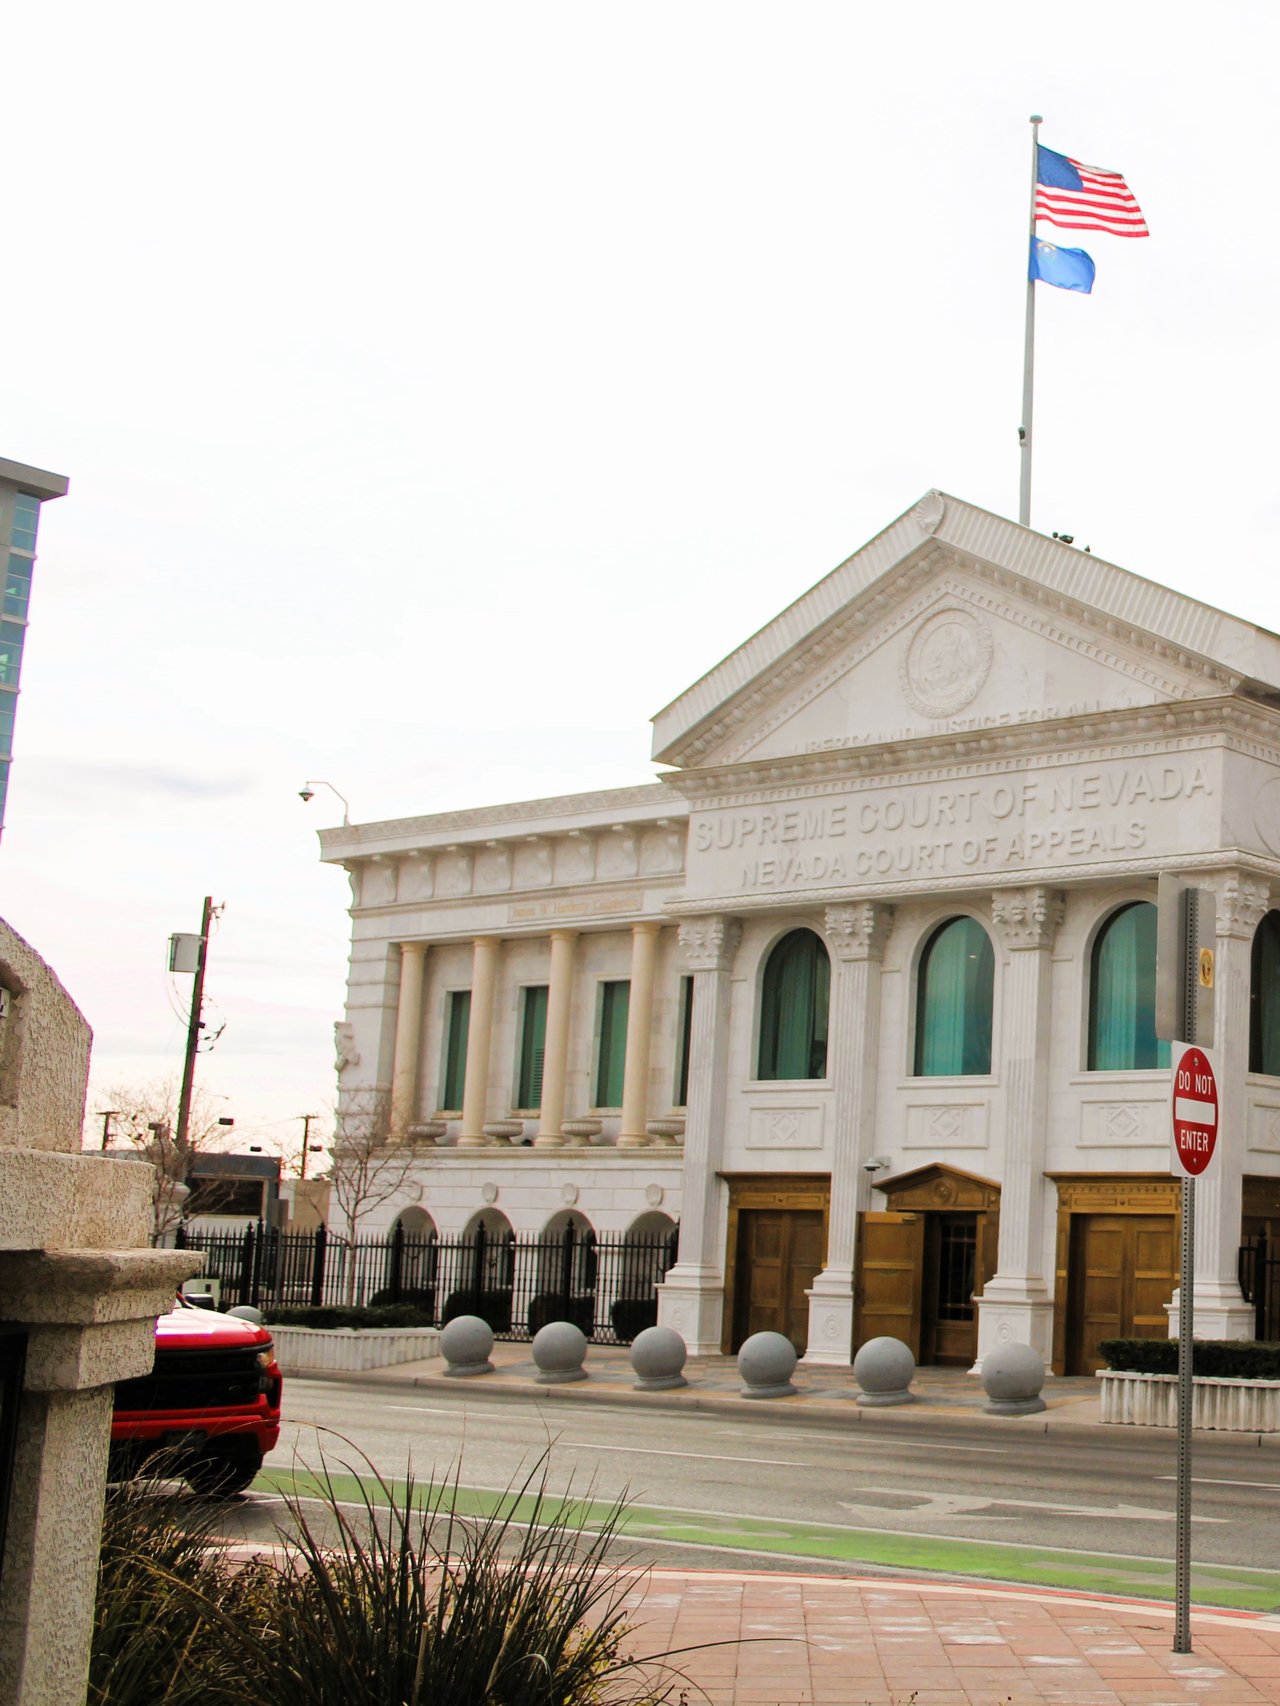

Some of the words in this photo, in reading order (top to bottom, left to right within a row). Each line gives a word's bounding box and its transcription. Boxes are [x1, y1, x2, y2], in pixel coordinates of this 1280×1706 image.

[928, 712, 1011, 735] JUSTICE
[1019, 706, 1060, 723] FOR
[696, 805, 848, 852] SUPREME
[859, 788, 979, 834] COURT
[989, 781, 1038, 820] OF
[1050, 761, 1213, 814] NEVADA
[742, 851, 848, 888] NEVADA
[856, 840, 954, 877] COURT
[961, 836, 998, 866] OF
[1005, 821, 1148, 862] APPEALS
[1178, 1070, 1191, 1091] DO
[1195, 1074, 1213, 1096] NOT
[1180, 1129, 1209, 1152] ENTER
